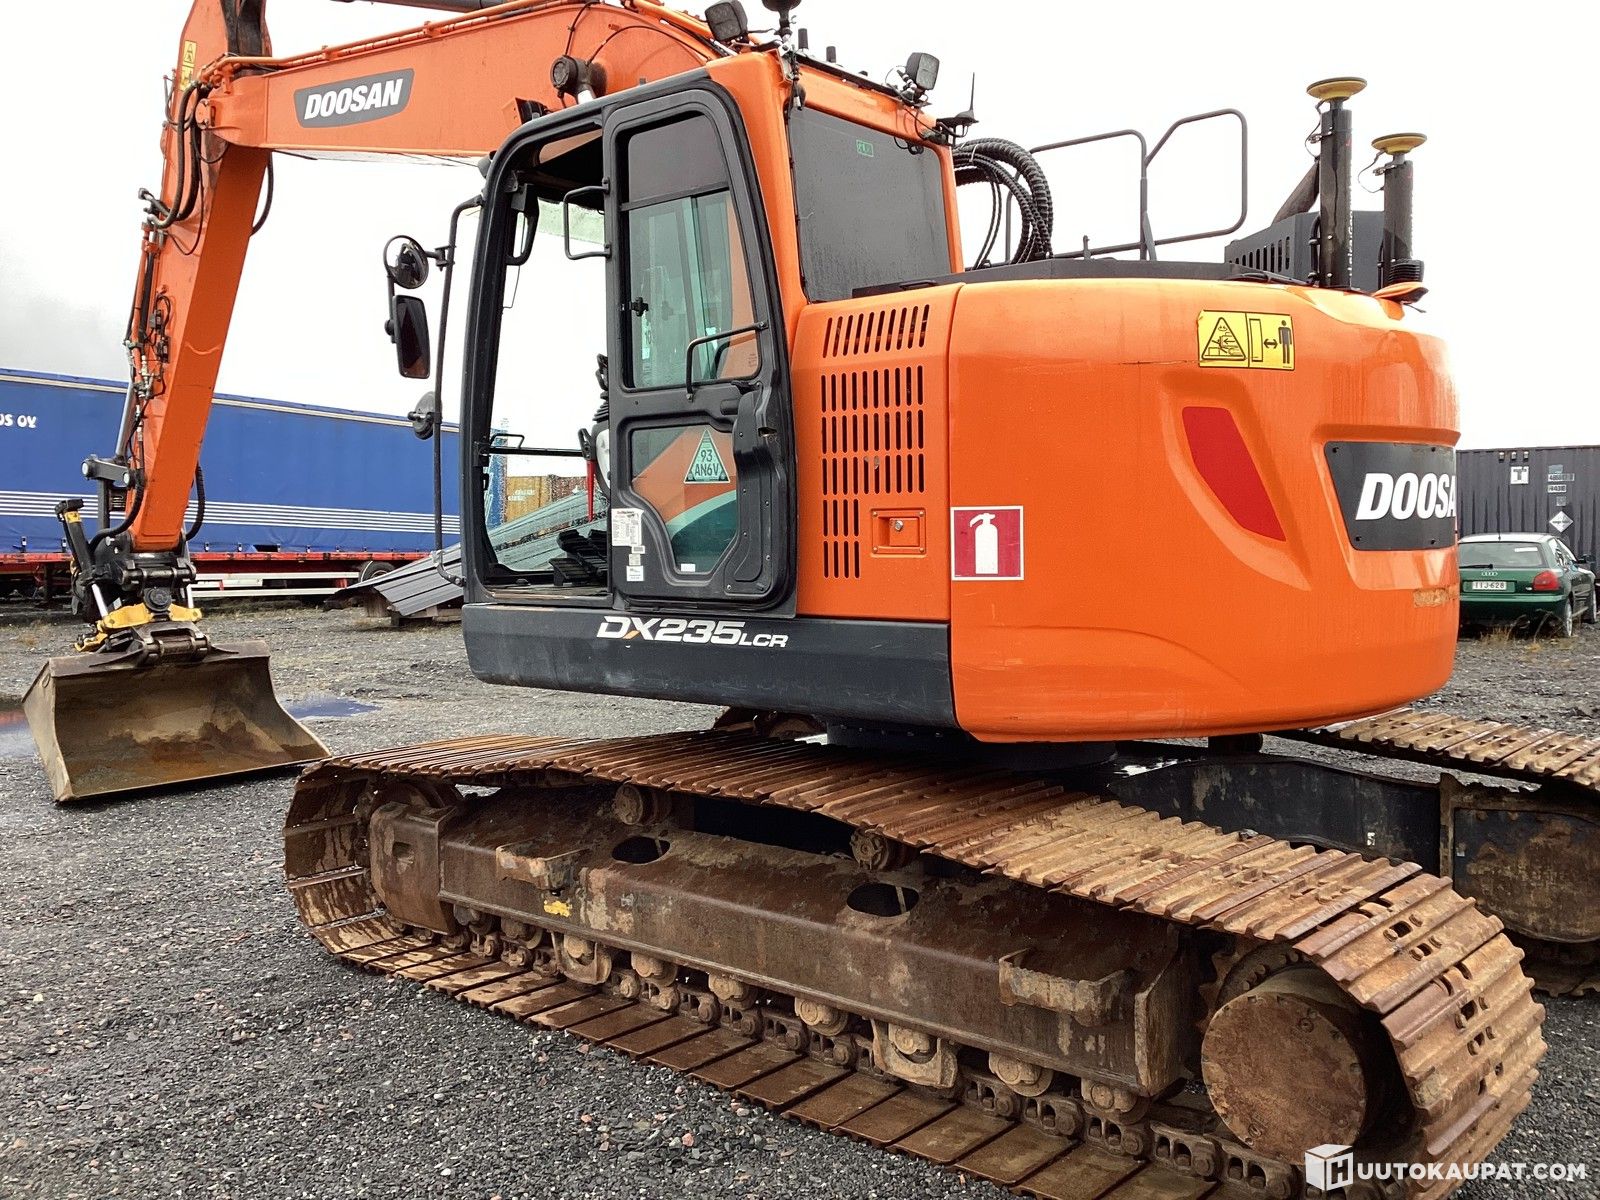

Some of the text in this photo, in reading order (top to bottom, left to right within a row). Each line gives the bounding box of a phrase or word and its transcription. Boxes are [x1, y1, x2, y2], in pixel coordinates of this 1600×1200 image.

[304, 79, 404, 119] DOOSAN
[700, 449, 713, 462] 93
[695, 463, 719, 476] AN6V
